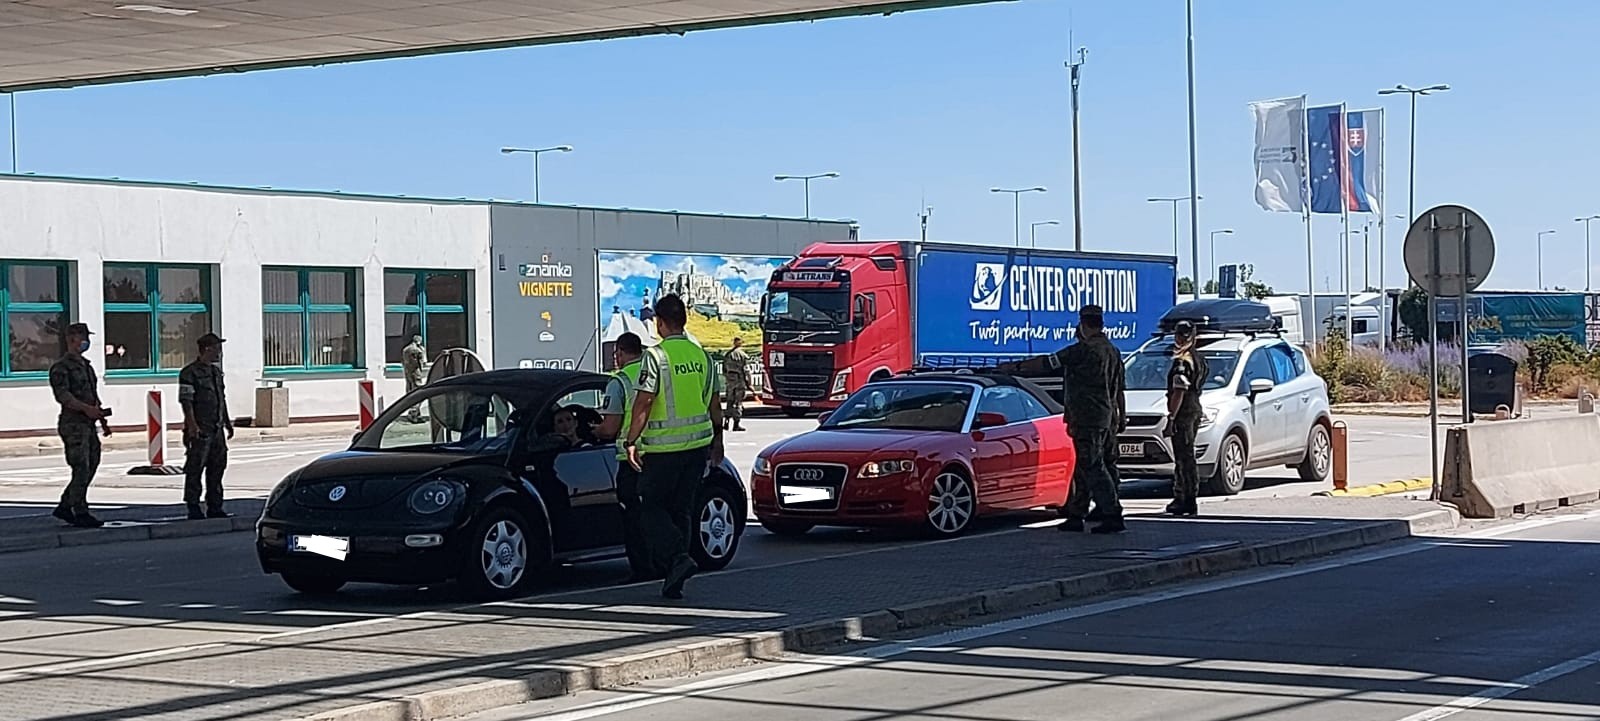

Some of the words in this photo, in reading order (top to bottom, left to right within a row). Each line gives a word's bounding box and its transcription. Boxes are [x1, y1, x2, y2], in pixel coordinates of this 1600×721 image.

[519, 281, 573, 297] VIGNETTE
[1010, 265, 1065, 311] CENTER
[1067, 267, 1137, 313] SPEDITION
[969, 319, 1000, 345] Twój
[1003, 321, 1050, 345] partner
